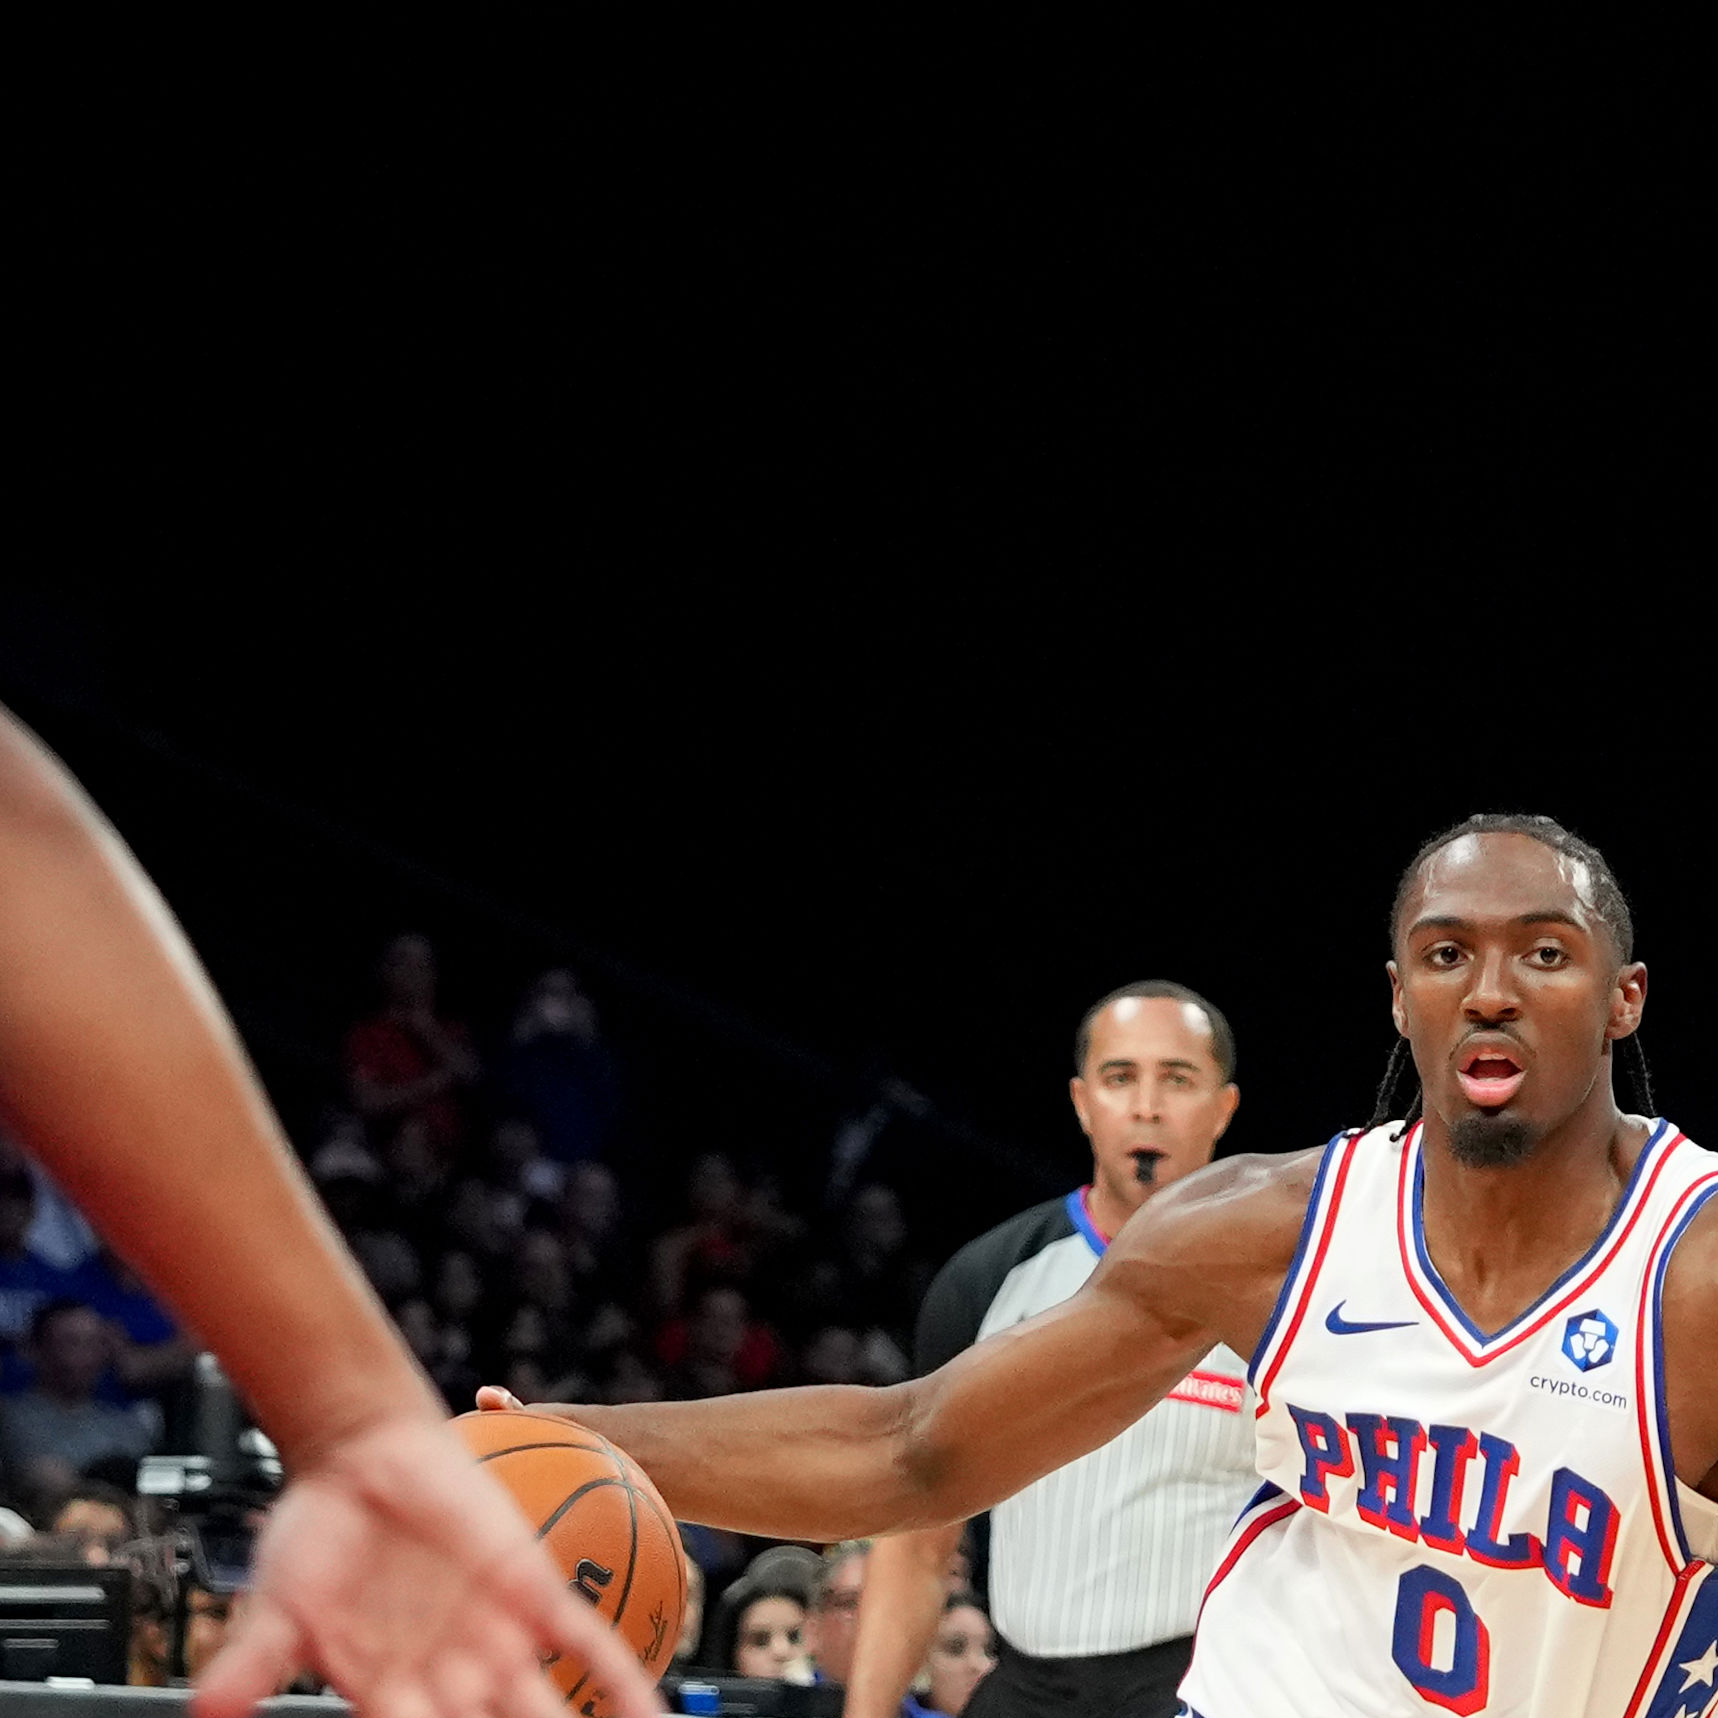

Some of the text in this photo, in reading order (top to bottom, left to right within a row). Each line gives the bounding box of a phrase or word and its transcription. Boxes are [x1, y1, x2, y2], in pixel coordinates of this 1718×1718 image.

[1529, 1375, 1628, 1409] crypto.com
[1287, 1403, 1622, 1610] PHILA
[1391, 1563, 1490, 1718] 0
